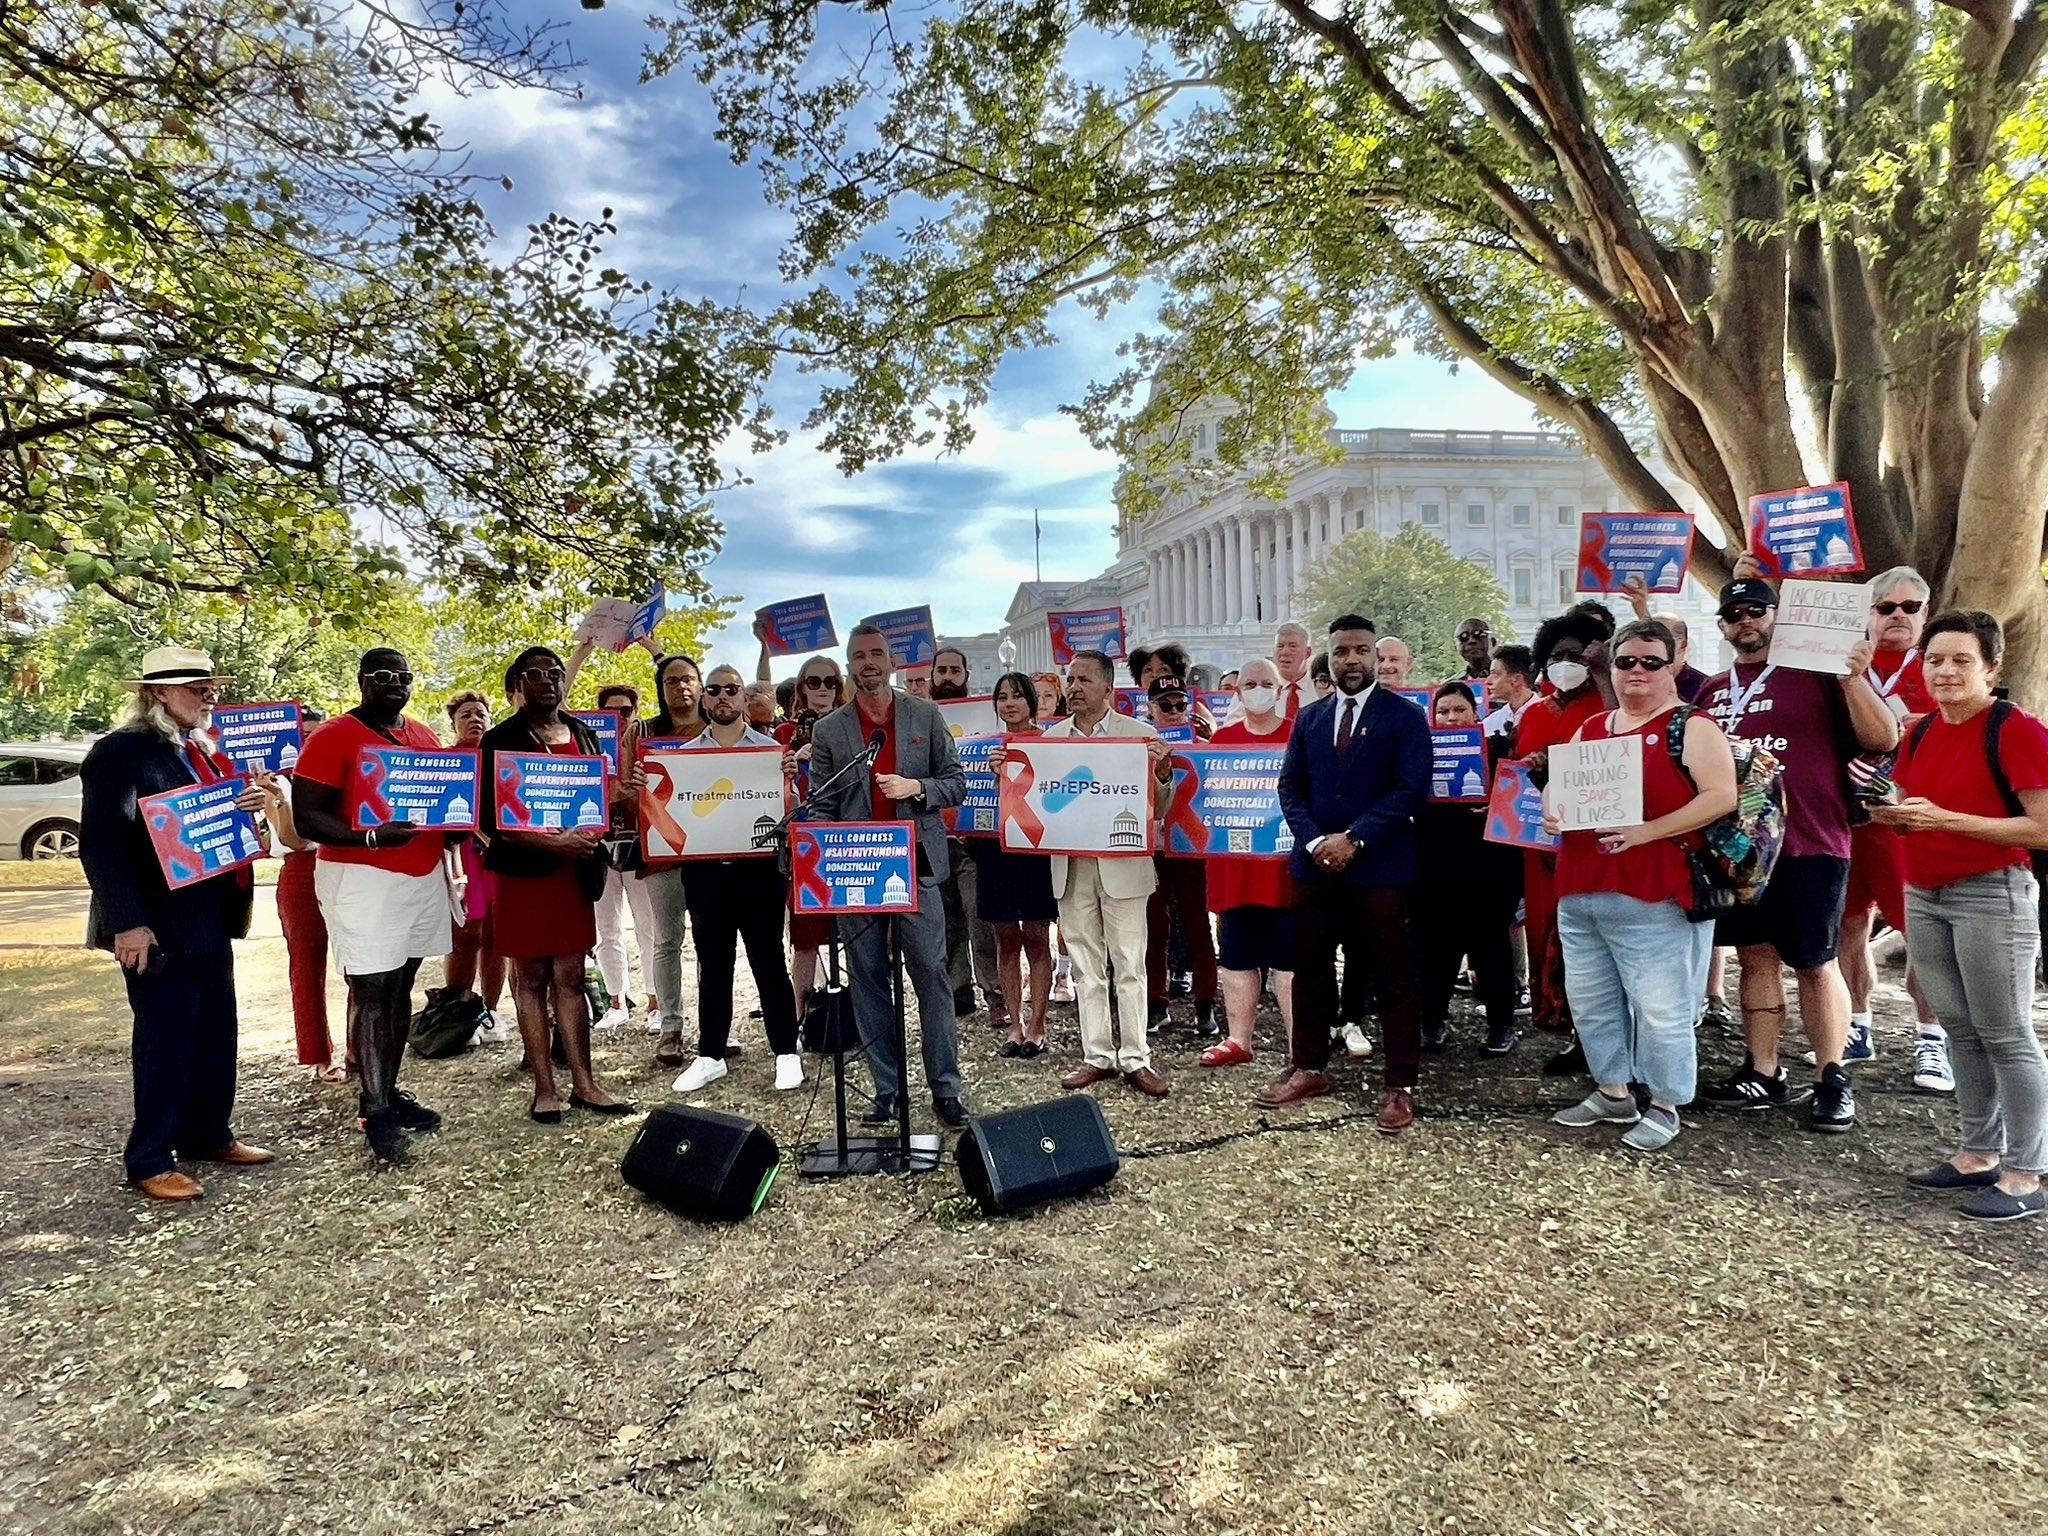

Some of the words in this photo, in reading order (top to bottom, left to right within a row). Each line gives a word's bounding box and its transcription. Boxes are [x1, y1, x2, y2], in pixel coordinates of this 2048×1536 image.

[1611, 522, 1630, 531] TELL
[1632, 523, 1677, 532] CONGRESS
[1790, 588, 1858, 610] INCREASE
[1788, 608, 1813, 623] HIV
[1817, 610, 1863, 628] FUNDING
[1160, 679, 1180, 689] U=U
[1748, 699, 1773, 713] an
[221, 714, 239, 724] TELL
[243, 710, 285, 722] CONGRESS
[223, 720, 297, 737] #SAVEHIVFUNDING
[225, 735, 276, 748] DOMESTICALLY
[957, 745, 978, 755] TELL
[1579, 744, 1612, 766] HIV
[390, 756, 410, 766] TELL
[414, 758, 461, 768] CONGRESS
[525, 762, 543, 772] TELL
[546, 764, 589, 773] CONGRESS
[1204, 759, 1228, 770] TELL
[389, 769, 475, 781] #SAVEHIVFUNDING
[524, 775, 602, 786] #SAVEHIVFUNDING
[1563, 764, 1629, 790] FUNDING
[388, 784, 447, 794] DOMESTICALLY
[525, 788, 577, 798] DOMESTICALLY
[1039, 780, 1139, 795] #PrEPSaves
[677, 789, 781, 802] #TreatmentSaves
[1577, 787, 1622, 805] SAVES
[177, 798, 197, 811] TELL
[397, 798, 439, 808] GLOBALLY!
[533, 801, 570, 810] GLOBALLY!
[1203, 797, 1275, 809] DOMESTICALLY
[1577, 803, 1626, 824] LIVES
[1203, 815, 1211, 826] &
[1214, 816, 1265, 827] GLOBALLY!
[824, 833, 843, 843] TELL
[847, 832, 894, 843] CONGRESS
[824, 846, 908, 858] #SAVEHIVFUNDING
[825, 861, 881, 872] DOMESTICALLY
[826, 877, 833, 886] &
[835, 876, 875, 886] GLOBALLY!
